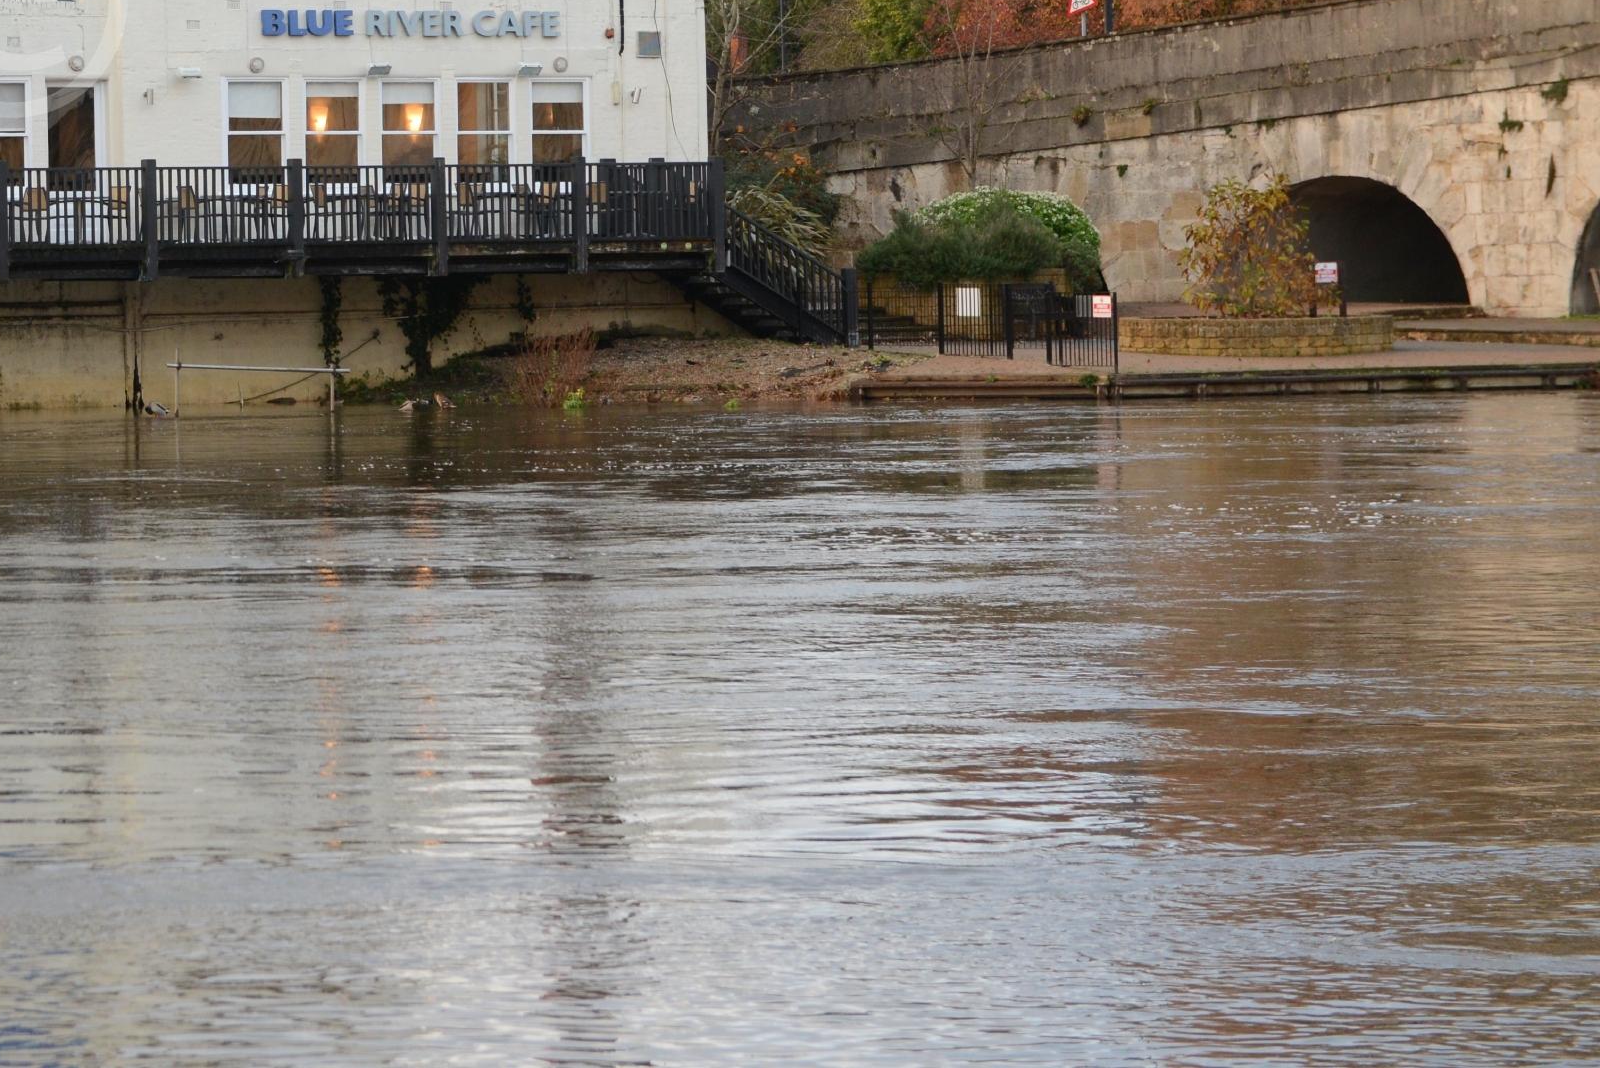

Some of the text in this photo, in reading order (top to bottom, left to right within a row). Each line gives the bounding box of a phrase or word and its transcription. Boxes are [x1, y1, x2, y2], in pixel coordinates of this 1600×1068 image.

[261, 9, 561, 38] BLUE RIVER CAFE
